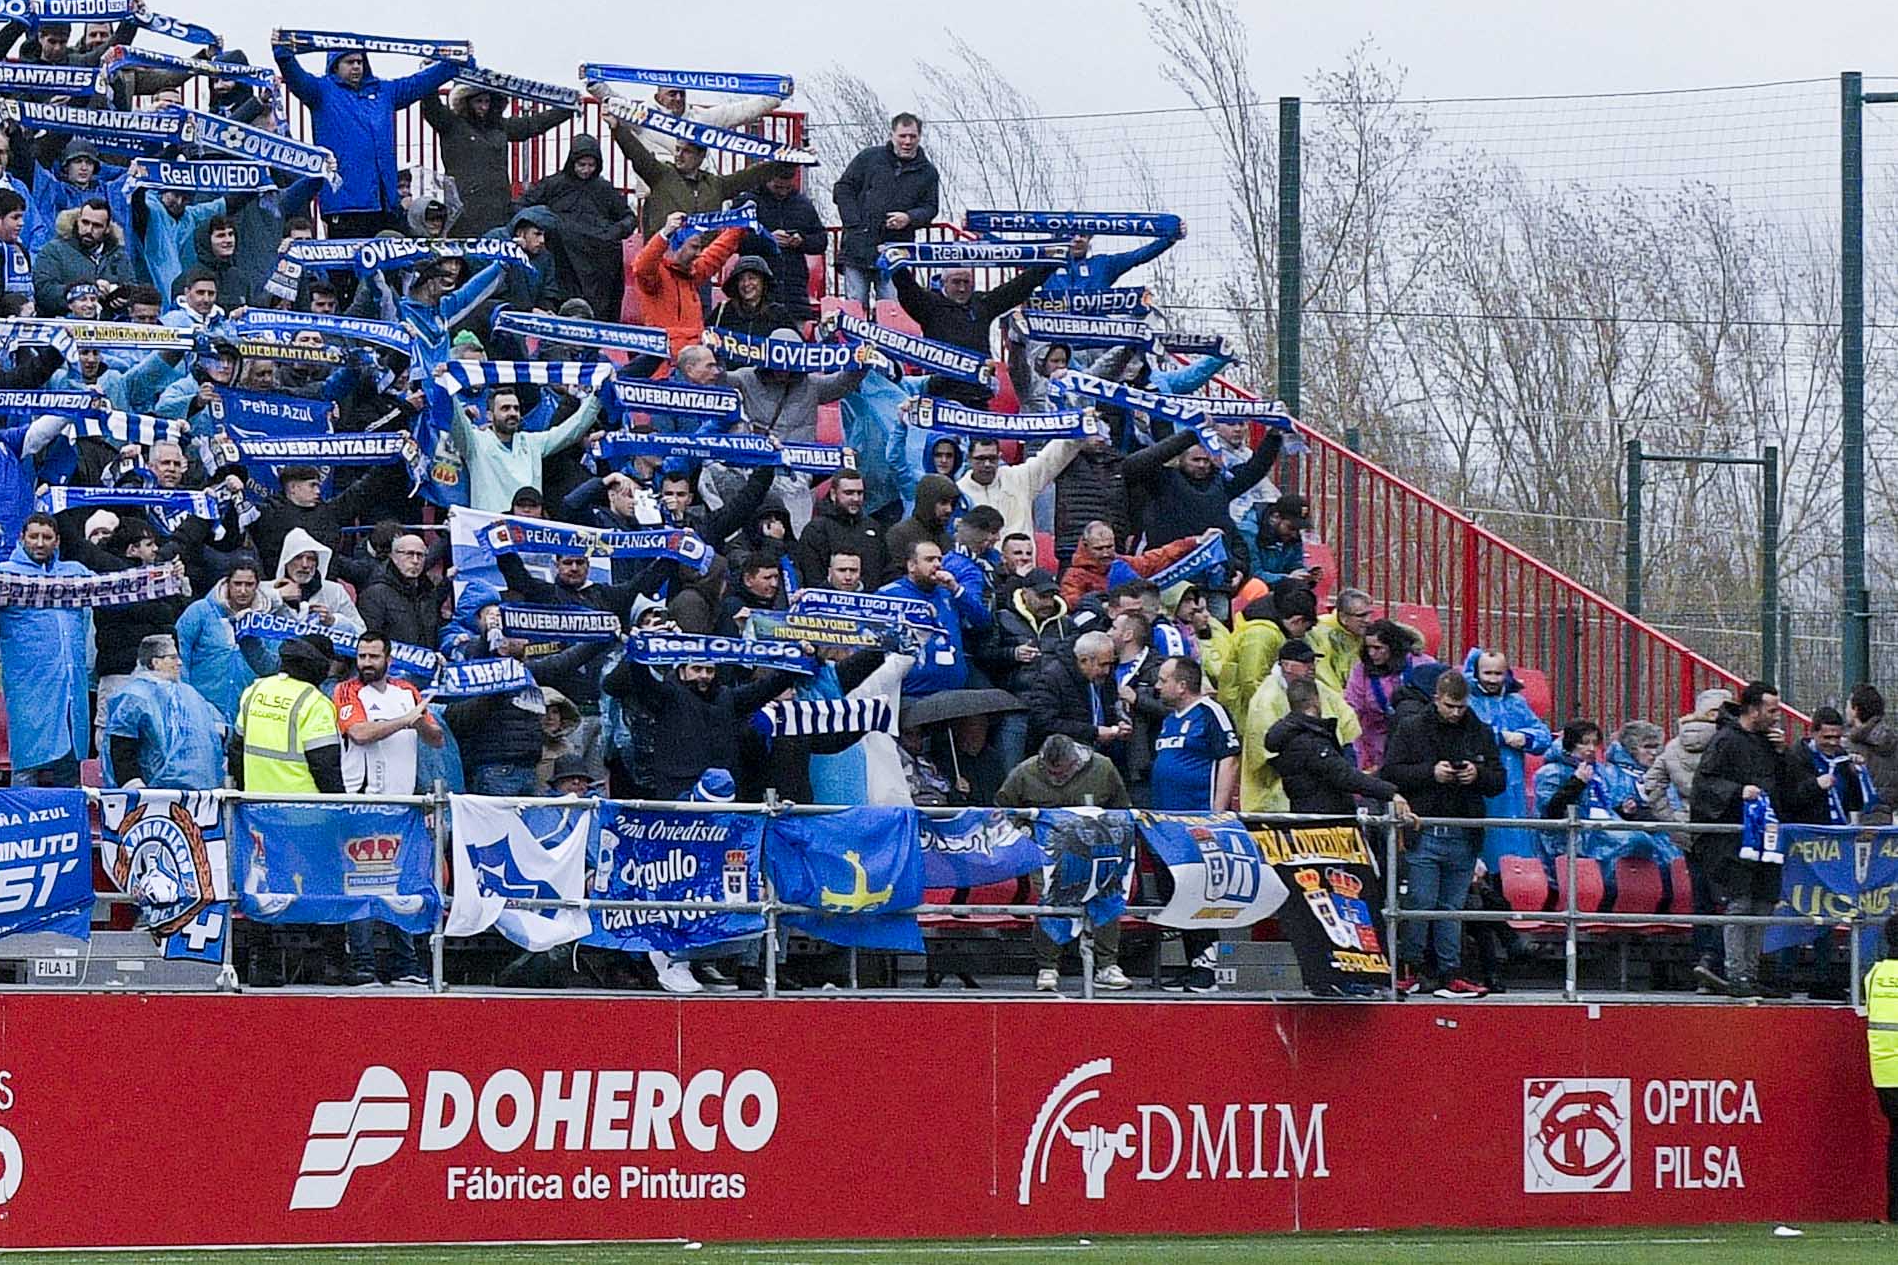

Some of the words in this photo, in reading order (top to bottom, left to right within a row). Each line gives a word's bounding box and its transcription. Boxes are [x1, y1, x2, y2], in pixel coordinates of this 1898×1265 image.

[676, 72, 741, 88] OVIEDO
[24, 101, 179, 133] INQUEBRANTABLES
[649, 112, 696, 141] REAL
[700, 128, 772, 155] OVIEDO
[243, 137, 324, 172] OVIEDO
[160, 162, 196, 185] Real
[200, 164, 260, 188] OVIEDO
[932, 244, 965, 261] Real
[1030, 291, 1069, 313] Real
[1072, 290, 1139, 312] OVIEDO
[1027, 314, 1154, 340] INQUEBRANTABLES
[724, 339, 766, 361] Real
[771, 343, 849, 366] OVIEDO
[842, 314, 979, 373] INQUEBRANTABLES
[242, 399, 279, 417] Peña
[280, 404, 314, 423] Azul
[614, 383, 738, 413] NQUEBRANTABLES
[938, 407, 1082, 431] INQUEBRANTABLES
[240, 437, 405, 457] INQUEBRANTABLES
[525, 527, 562, 545] PEÑA
[607, 533, 668, 550] LLANISCA
[505, 615, 620, 633] INQUEBRANTABLES
[648, 638, 704, 654] Real
[709, 639, 802, 659] Oviedo
[28, 806, 71, 825] AZUL
[647, 820, 729, 842] Oviedista
[619, 848, 698, 892] Orgullo
[38, 961, 62, 975] FILA
[65, 961, 71, 975] 1
[418, 1068, 779, 1153] DOHERCO
[1643, 1079, 1762, 1126] OPTICA
[1136, 1102, 1330, 1182] DMIM
[1654, 1145, 1745, 1190] PILSA
[446, 1165, 564, 1200] Fábrica
[572, 1166, 611, 1200] de
[620, 1165, 747, 1200] Pinturas
